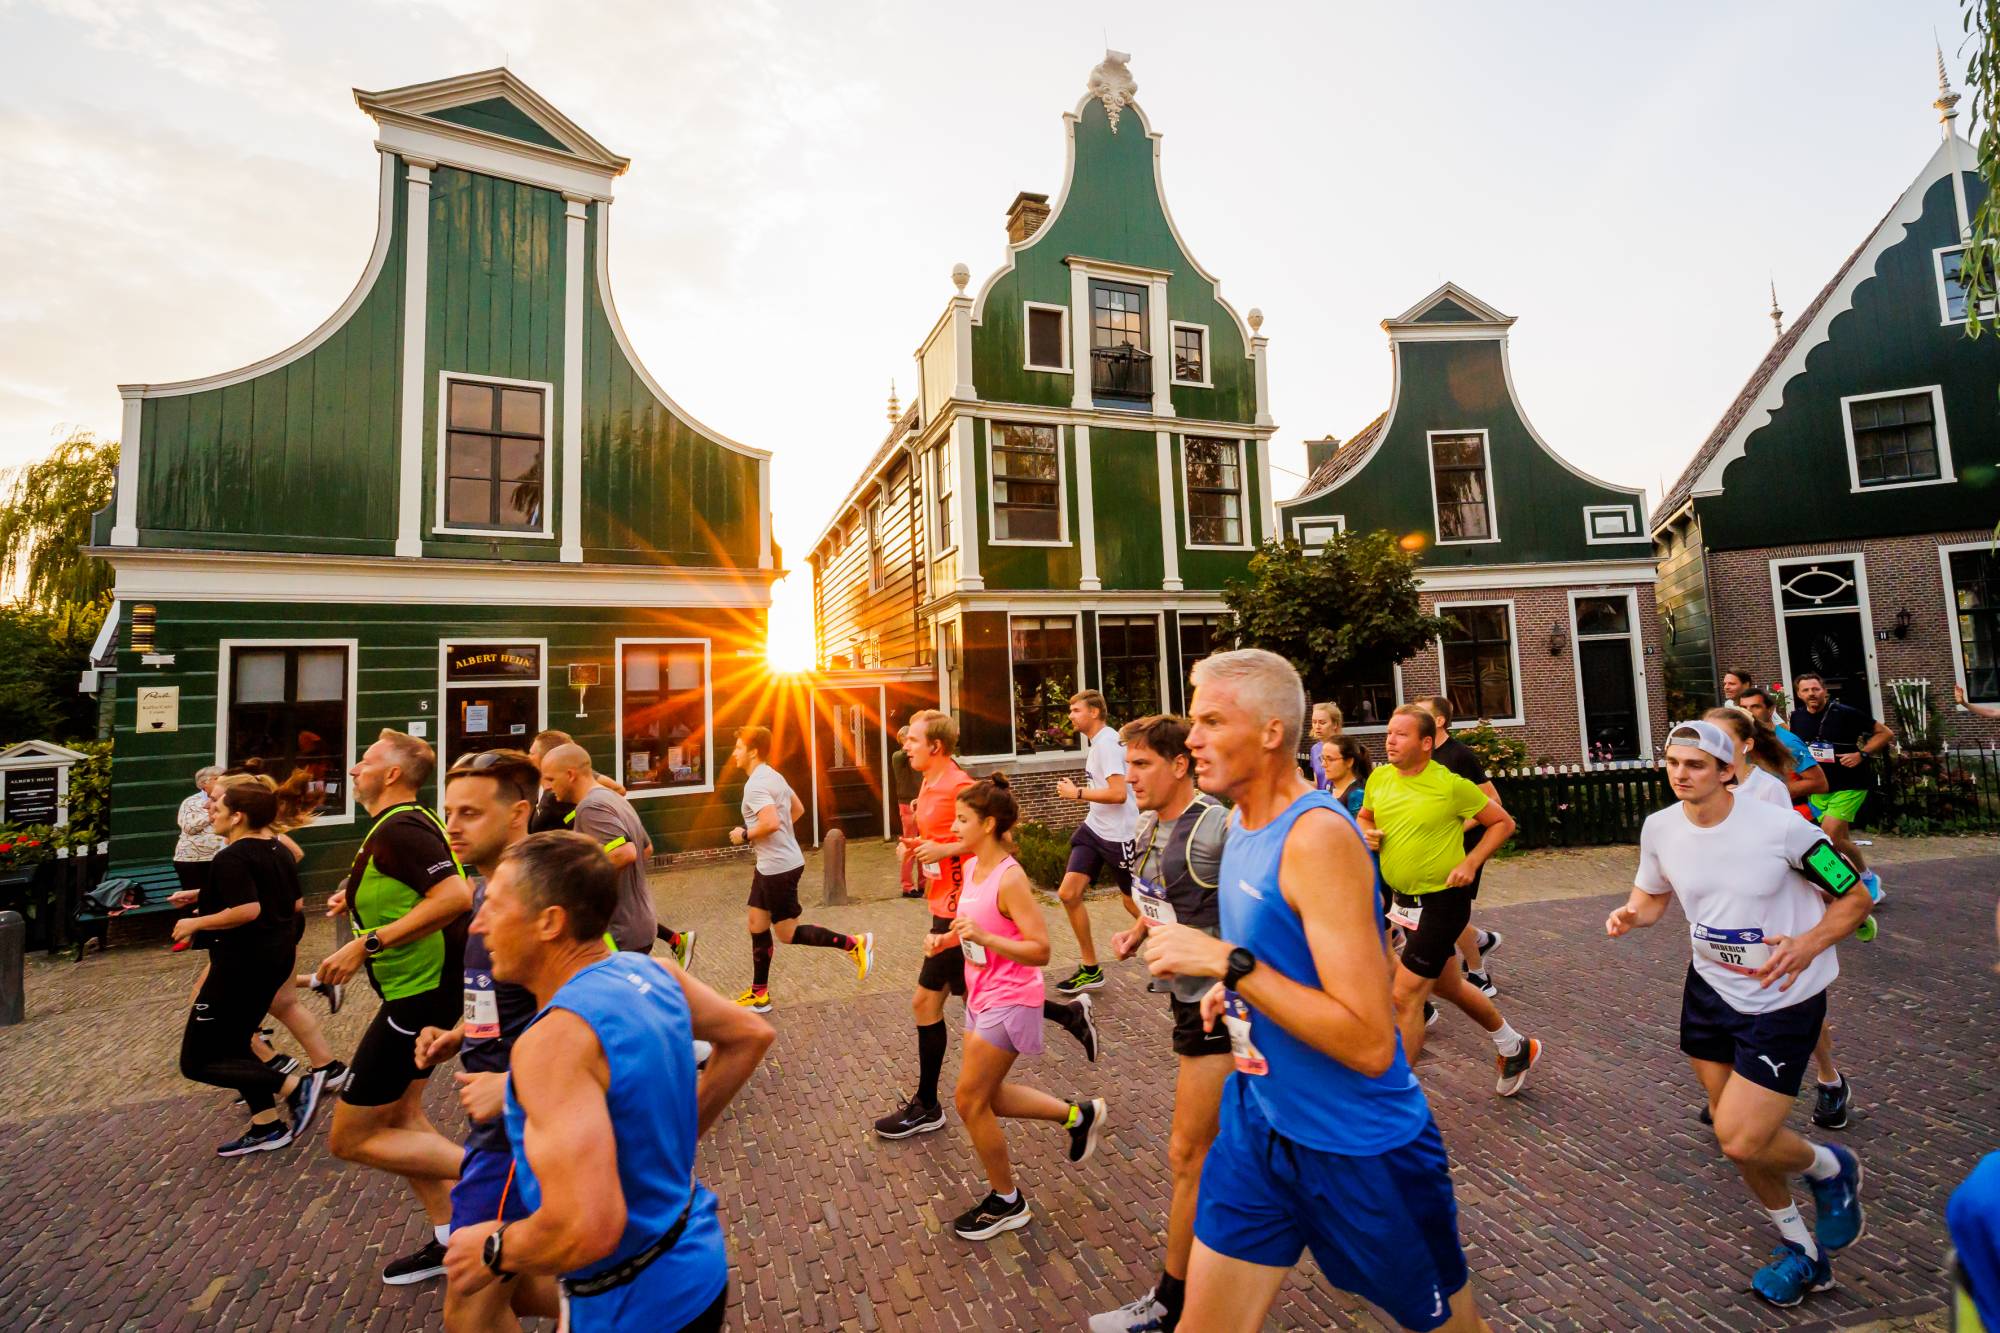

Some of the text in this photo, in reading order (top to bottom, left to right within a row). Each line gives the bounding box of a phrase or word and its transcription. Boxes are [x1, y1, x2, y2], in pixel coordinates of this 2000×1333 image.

[1647, 647, 1653, 655] 9
[455, 654, 498, 669] ALBERT
[420, 701, 428, 711] 5
[1709, 942, 1747, 953] DIEDERICK
[1719, 951, 1744, 966] 972
